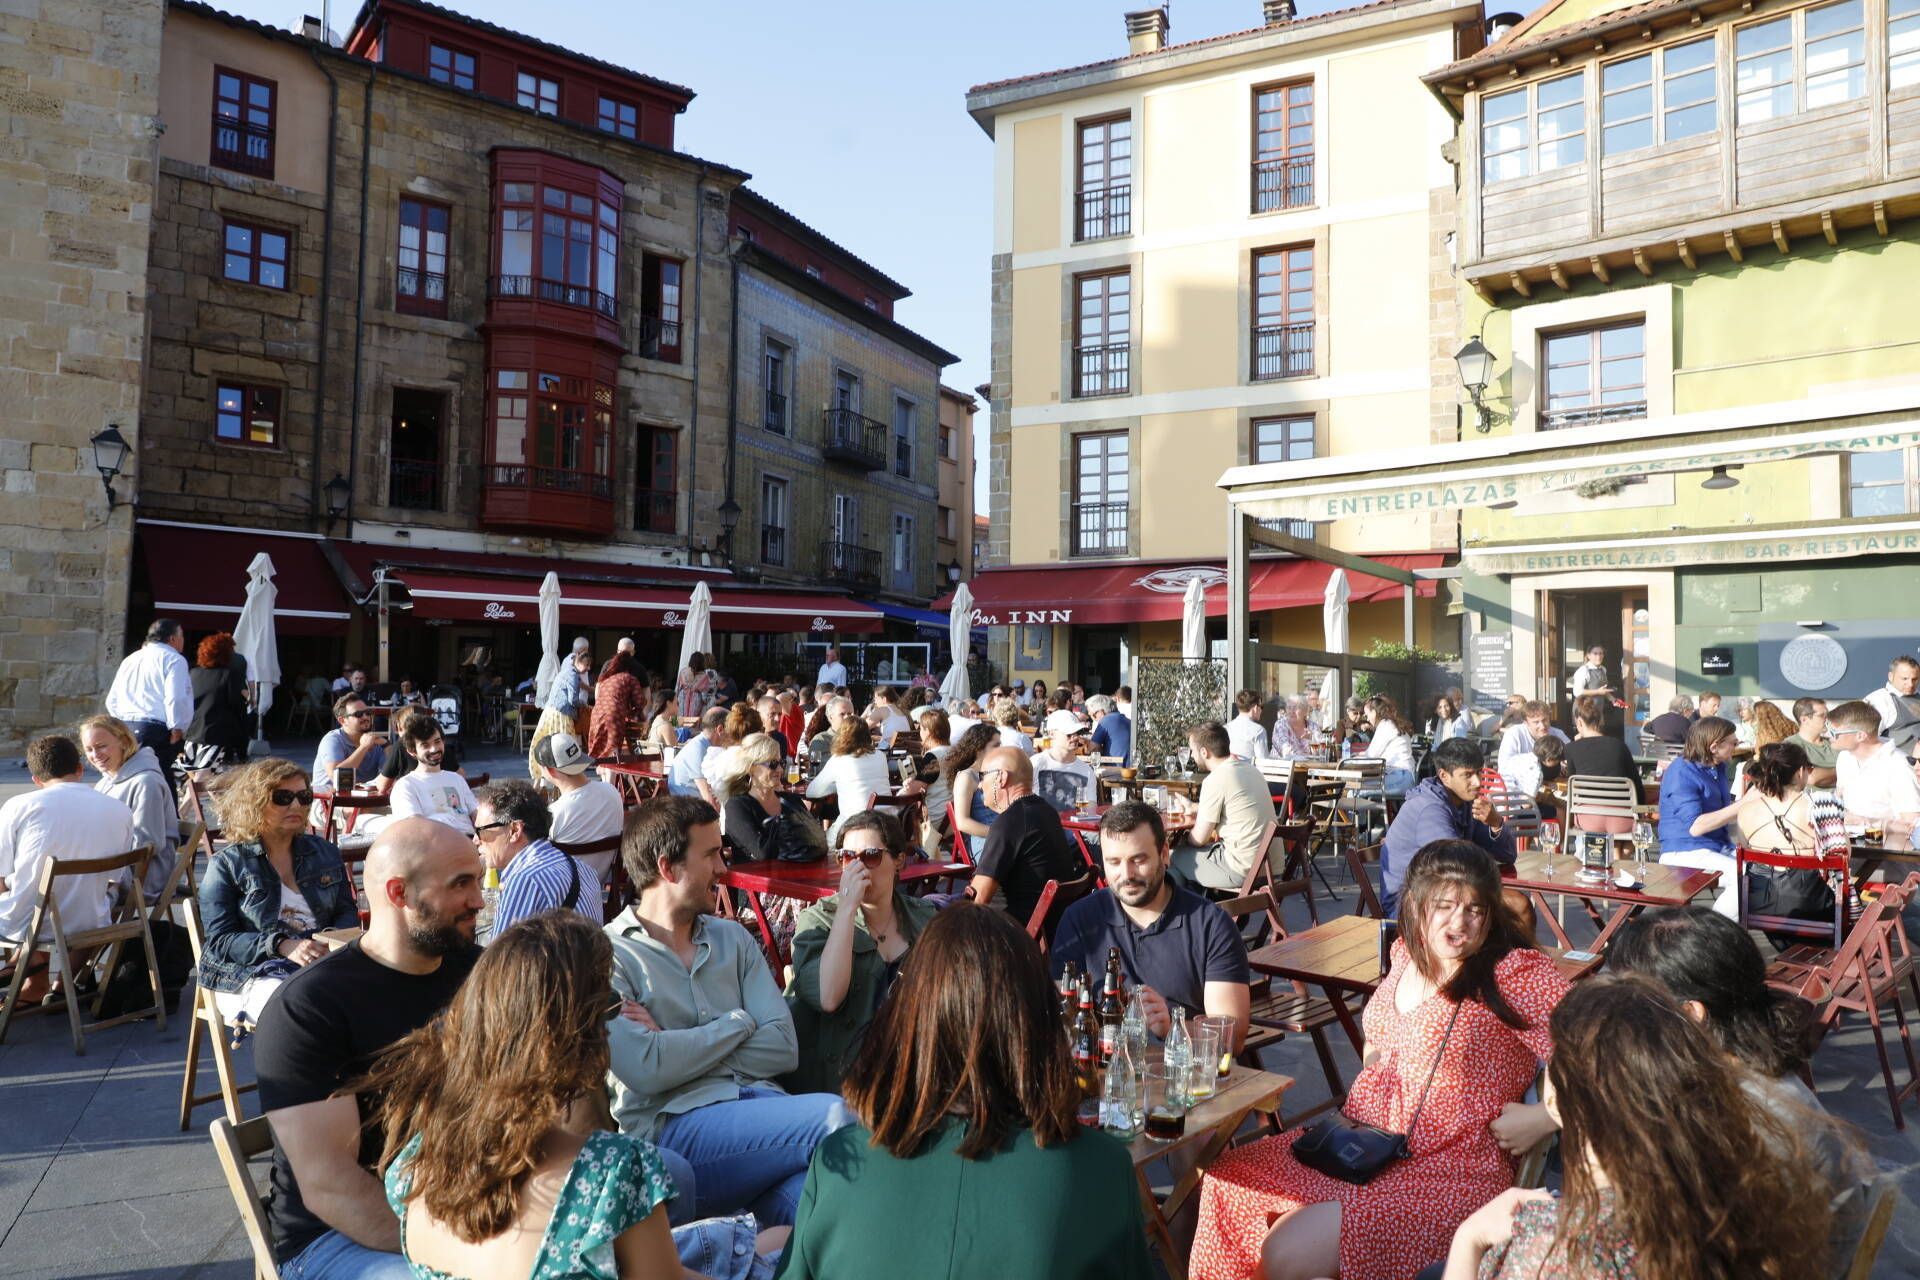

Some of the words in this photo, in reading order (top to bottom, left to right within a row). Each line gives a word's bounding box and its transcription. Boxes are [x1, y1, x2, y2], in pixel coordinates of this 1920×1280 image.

[1328, 481, 1517, 516] ENTREPLAZAS
[1527, 550, 1677, 569] ENTREPLAZAS
[484, 602, 516, 619] Palace
[661, 611, 687, 627] Palac
[971, 608, 999, 626] Bar
[1008, 610, 1073, 624] INN
